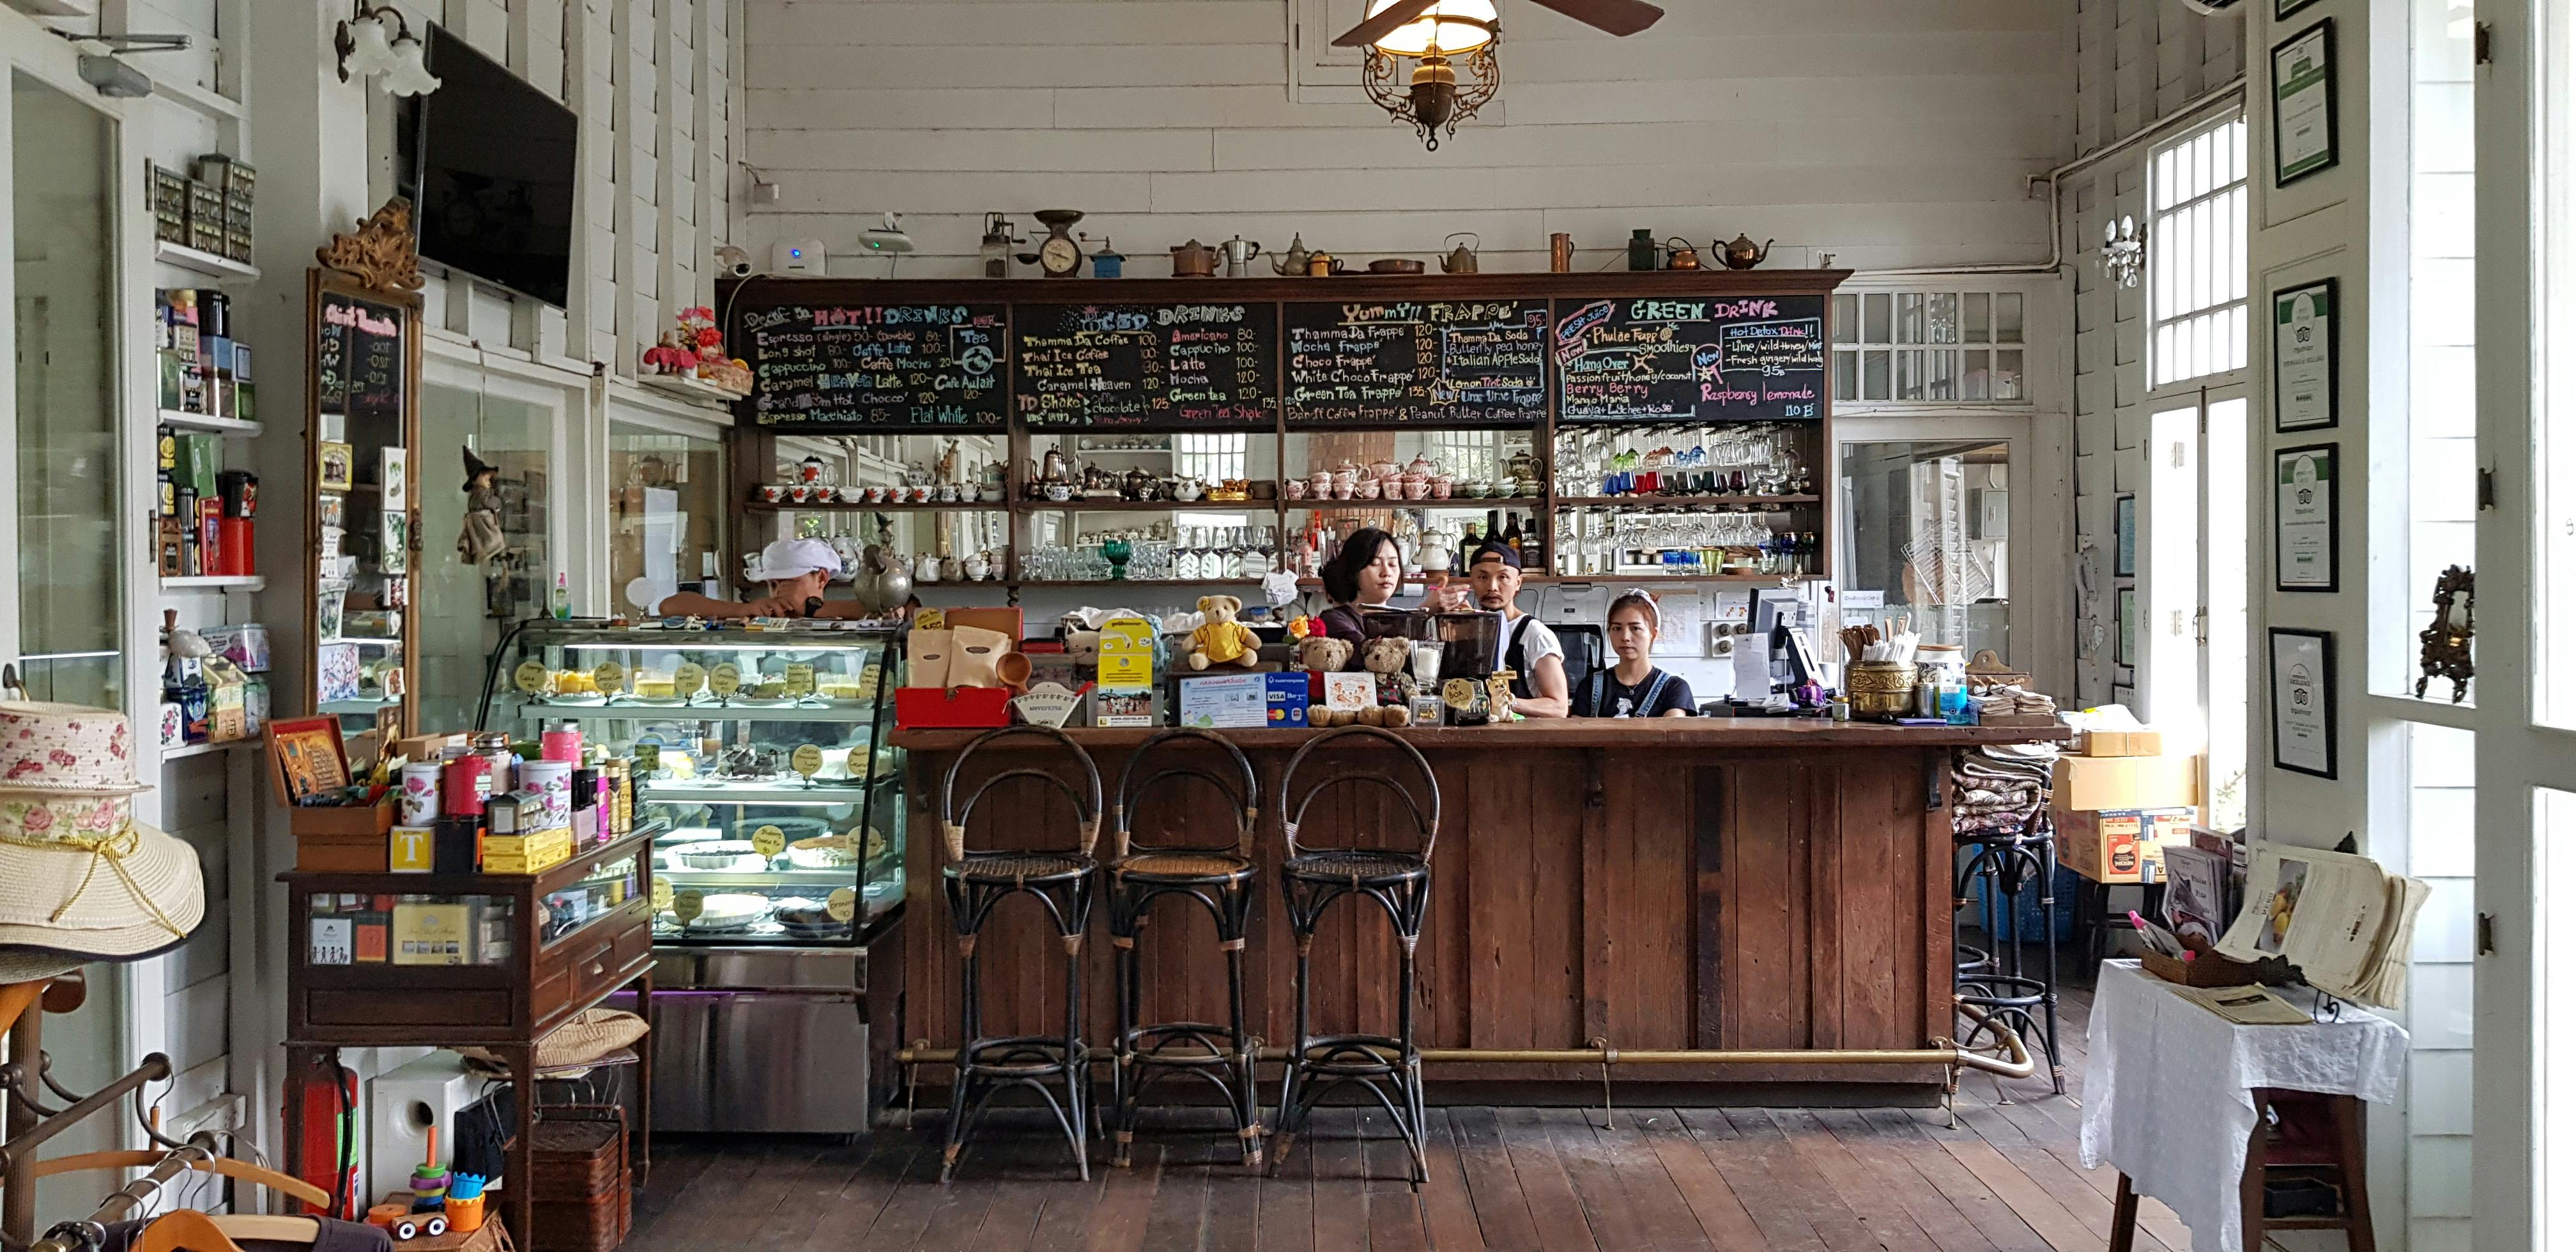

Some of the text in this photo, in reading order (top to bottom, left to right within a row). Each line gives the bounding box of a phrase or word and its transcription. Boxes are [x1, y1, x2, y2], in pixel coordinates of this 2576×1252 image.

[884, 305, 968, 324] DRINKS
[1156, 305, 1245, 326] DRINKS
[1631, 300, 1705, 319] GREEN
[960, 330, 989, 344] Tea
[1172, 328, 1229, 342] Americano
[1506, 329, 1528, 340] Soda
[1730, 326, 1749, 337] Hot
[757, 332, 813, 348] Espresso
[1095, 334, 1129, 346] Coffee
[758, 347, 788, 360] Long
[793, 344, 816, 358] shot
[1449, 343, 1492, 356] Butterfly
[1516, 340, 1544, 351] honey
[1561, 345, 1583, 361] New
[1022, 350, 1051, 363] Thai
[1054, 349, 1073, 362] Ice
[1076, 349, 1109, 361] Coffee
[1170, 356, 1206, 371] Latte
[1292, 354, 1332, 368] Choco
[1452, 354, 1490, 366] Italian
[758, 358, 826, 378] Cappuccino
[1023, 362, 1101, 377] Thai Ice Tea
[760, 375, 813, 392] Caramel
[876, 374, 903, 388] Latte
[1170, 372, 1209, 385] Mocha
[1291, 369, 1327, 383] White
[1331, 369, 1370, 382] Choco
[1502, 377, 1523, 388] Soda
[1038, 378, 1087, 391] Caramel
[1090, 377, 1131, 391] Heaven
[1566, 383, 1648, 399] Berry Berry
[833, 393, 855, 405] Hot
[1170, 388, 1206, 402] Green
[1208, 386, 1227, 401] tea
[1294, 386, 1334, 402] Green
[1335, 386, 1356, 400] Tea
[1567, 394, 1629, 406] Mango Mania
[1701, 381, 1815, 406] Raspberry lemonade
[1018, 393, 1039, 411] TD
[756, 411, 807, 424] Espresso
[810, 409, 862, 422] Macchiato
[910, 406, 933, 423] Flat
[937, 405, 968, 424] White
[1485, 408, 1515, 419] Coffee
[400, 834, 423, 861] T
